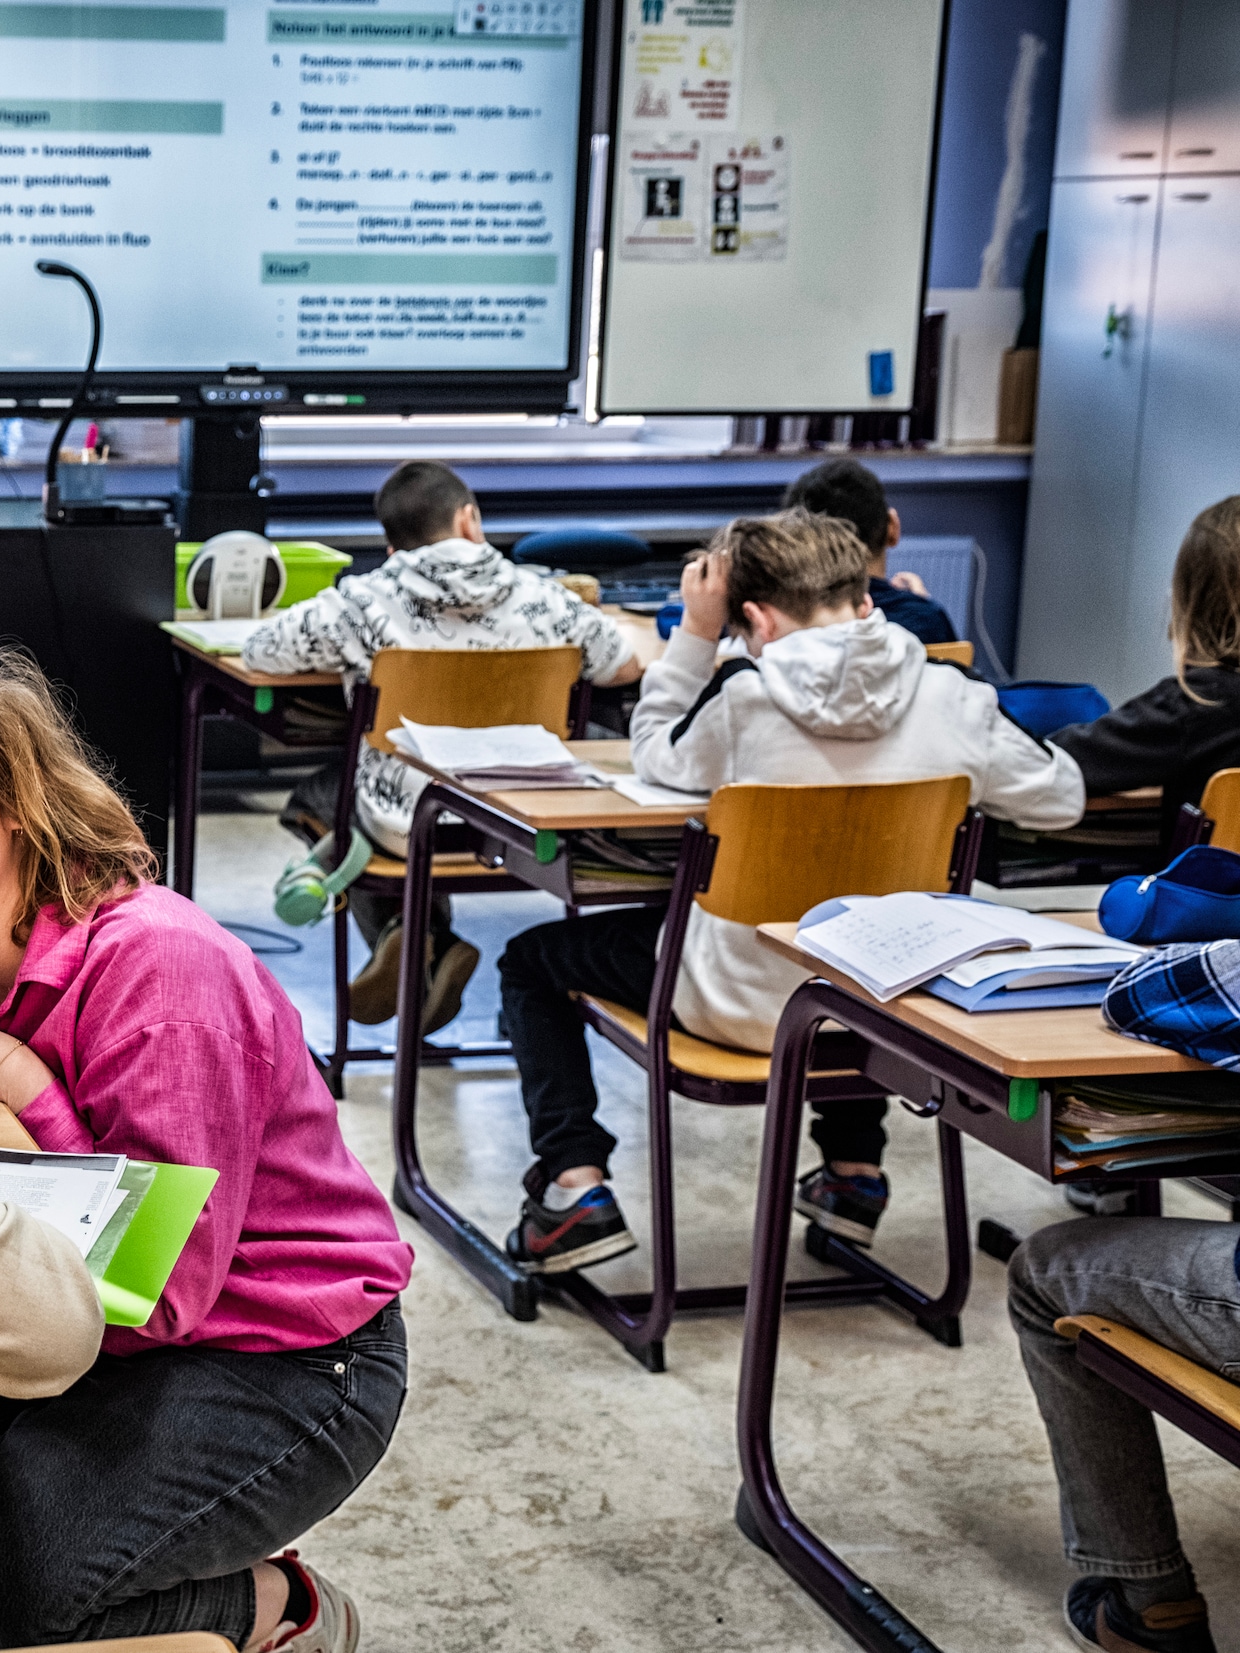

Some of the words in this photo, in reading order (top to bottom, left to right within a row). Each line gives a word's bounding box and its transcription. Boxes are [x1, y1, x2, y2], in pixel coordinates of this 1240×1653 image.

[273, 22, 321, 36] Noteer
[323, 22, 346, 36] het
[348, 23, 414, 37] antwoord
[415, 24, 429, 38] in
[430, 24, 446, 41] je
[337, 107, 360, 116] een
[450, 105, 474, 117] met
[328, 121, 344, 133] de
[42, 144, 152, 158] brooddozenbak
[23, 173, 112, 190] geodriehoek
[17, 205, 36, 219] op
[38, 202, 57, 216] de
[60, 202, 96, 216] bank
[296, 199, 315, 211] De
[459, 200, 476, 212] de
[472, 216, 490, 228] de
[29, 231, 103, 245] aanduiden
[106, 232, 120, 245] in
[123, 232, 150, 246] fluo
[266, 262, 309, 276] Klaar?
[377, 295, 394, 307] de
[297, 343, 368, 355] antwoorden
